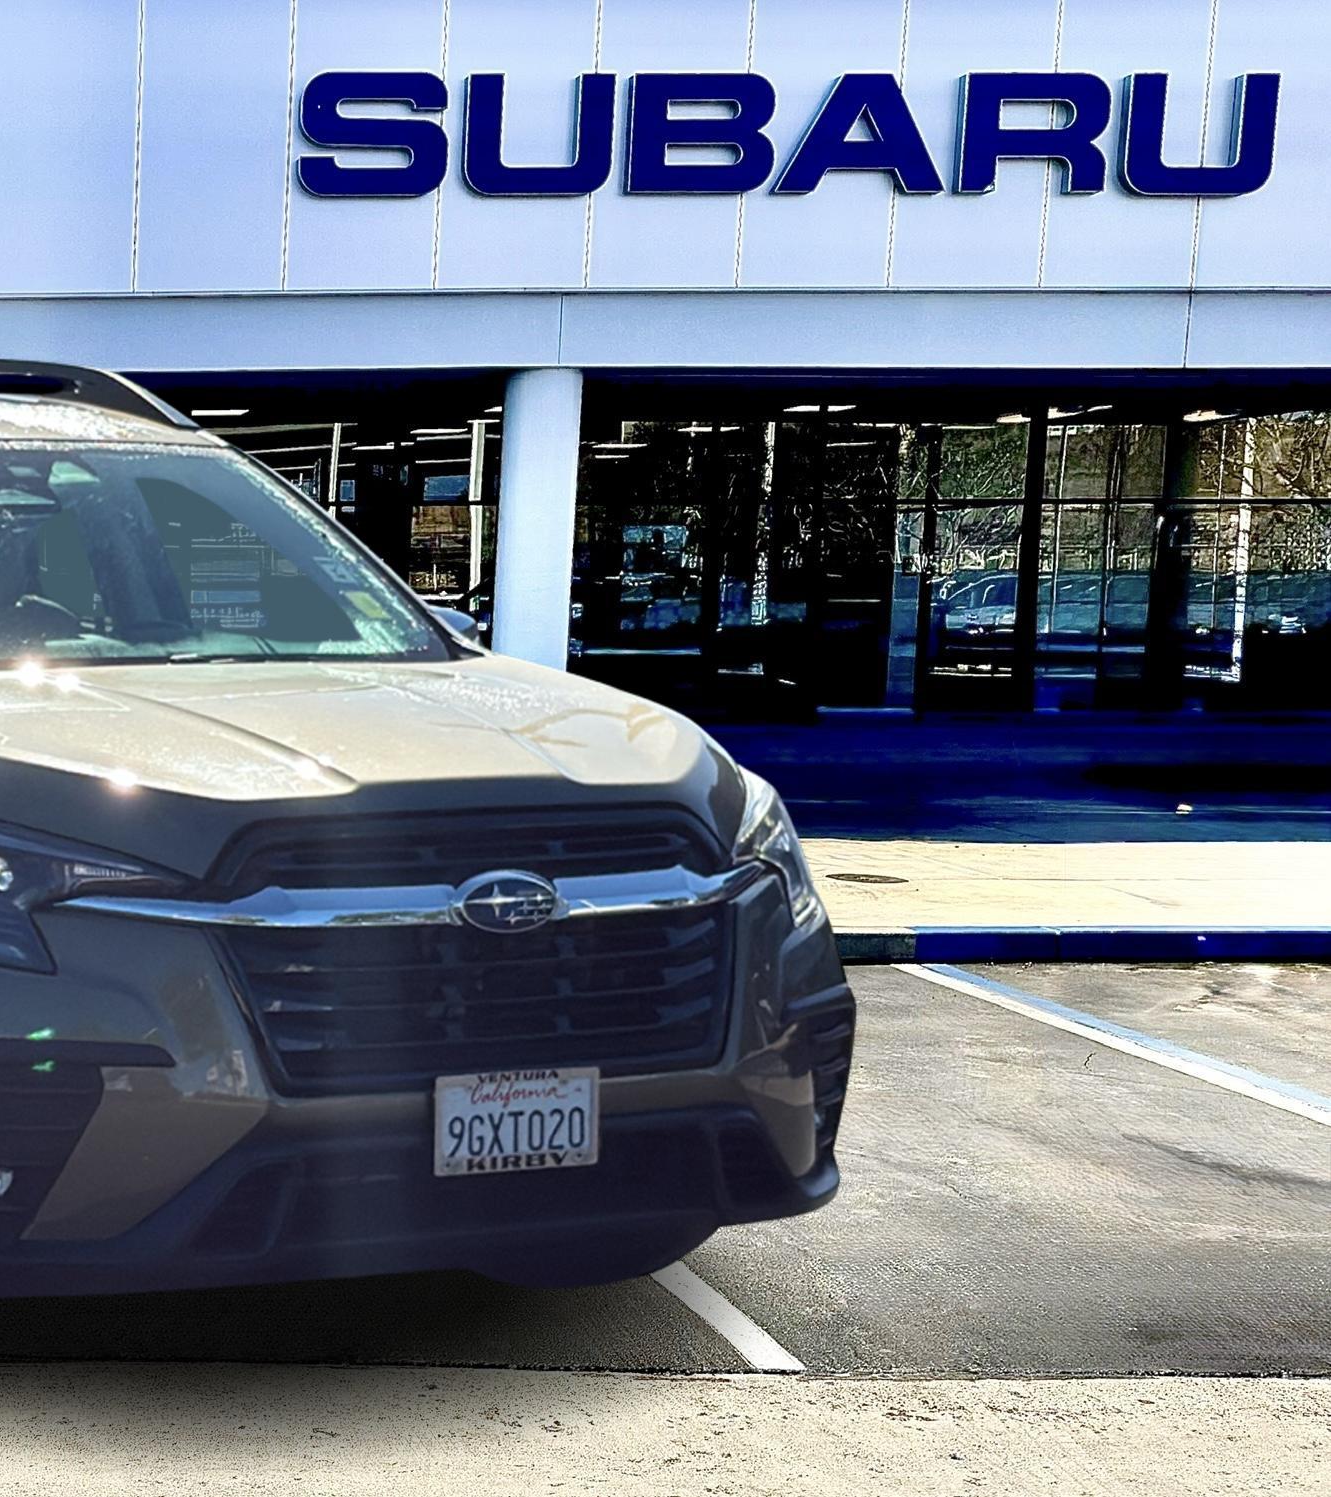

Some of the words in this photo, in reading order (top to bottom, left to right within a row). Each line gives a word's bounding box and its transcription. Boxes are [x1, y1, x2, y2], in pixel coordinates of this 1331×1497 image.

[297, 71, 1281, 197] SUBARU
[477, 1070, 559, 1084] VENTURA
[470, 1082, 568, 1108] California
[447, 1106, 586, 1159] 9GXT020
[466, 1152, 569, 1172] KIRBY
